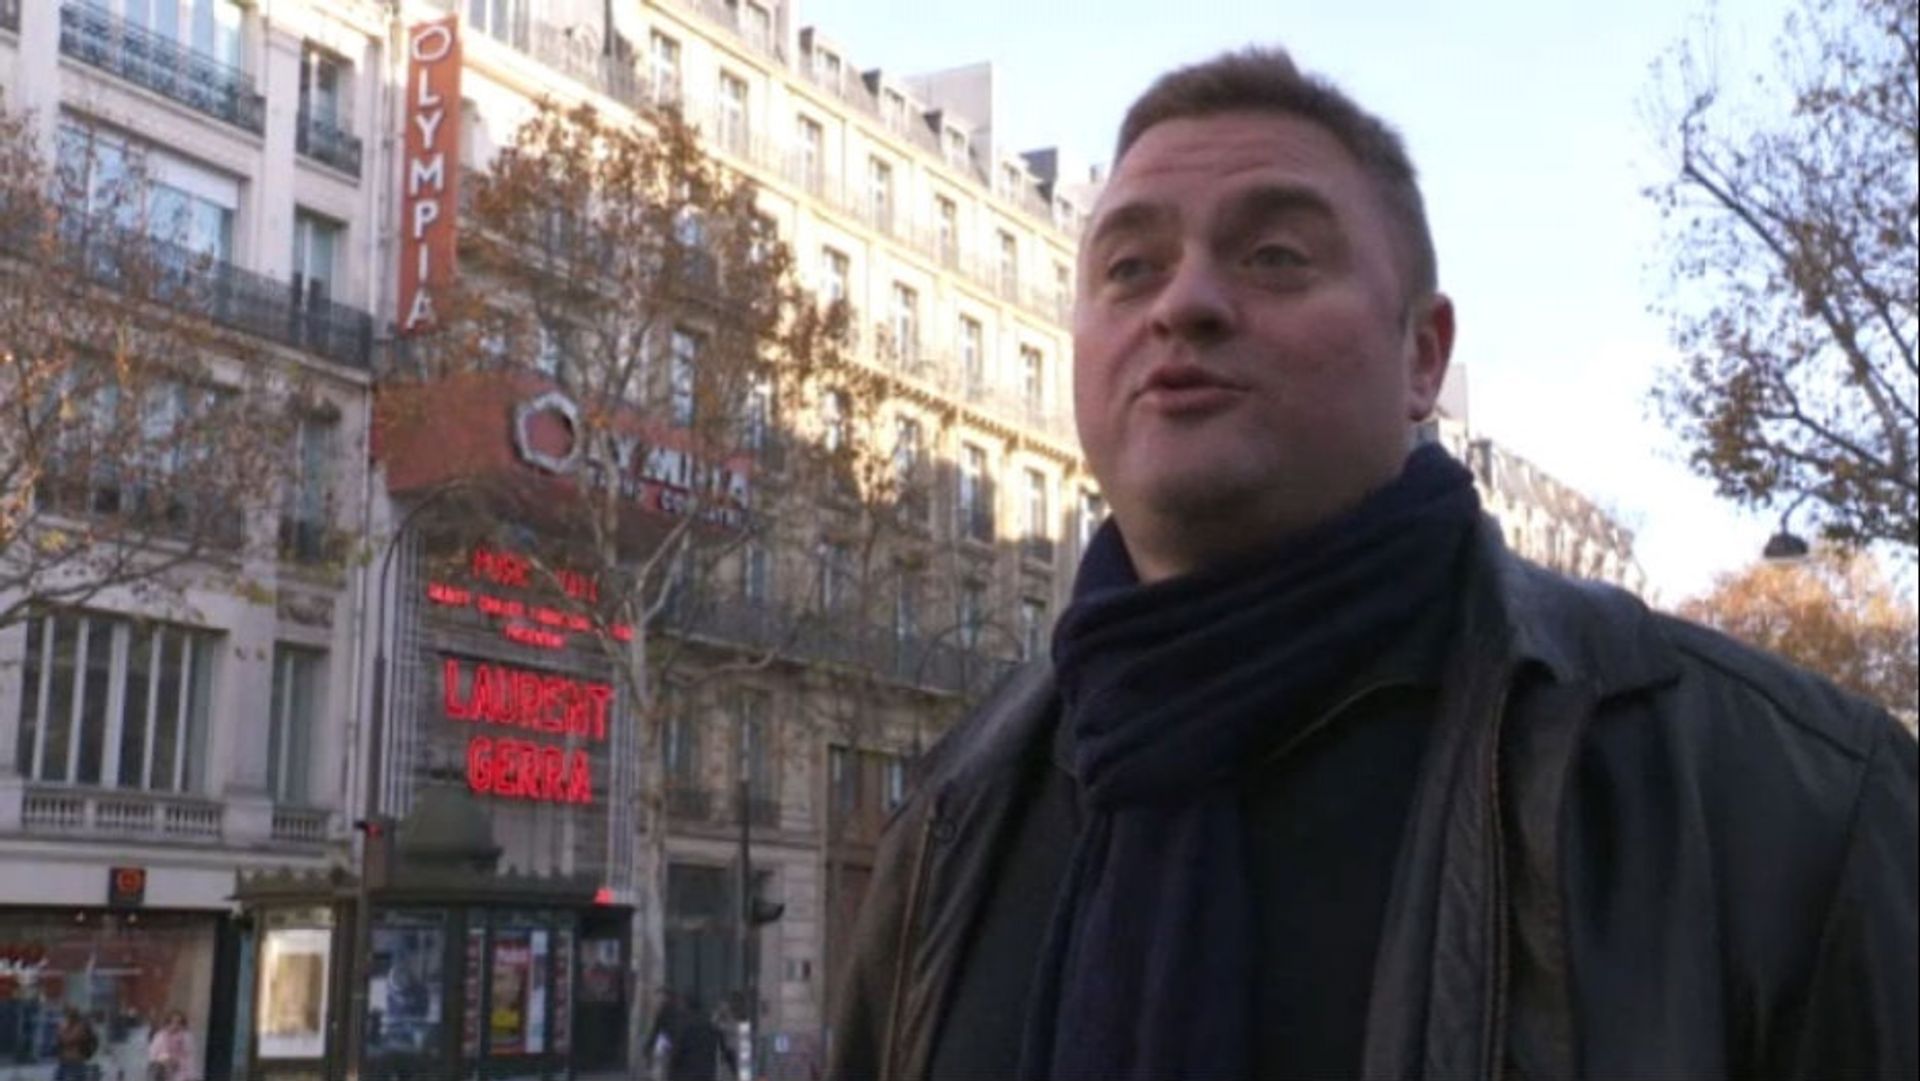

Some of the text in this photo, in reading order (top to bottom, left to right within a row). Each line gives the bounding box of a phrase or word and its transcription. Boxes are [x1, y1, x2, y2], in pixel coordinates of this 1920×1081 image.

[406, 25, 451, 330] OLYMPIA
[445, 659, 613, 741] LAURENT
[467, 734, 594, 804] GERRA
